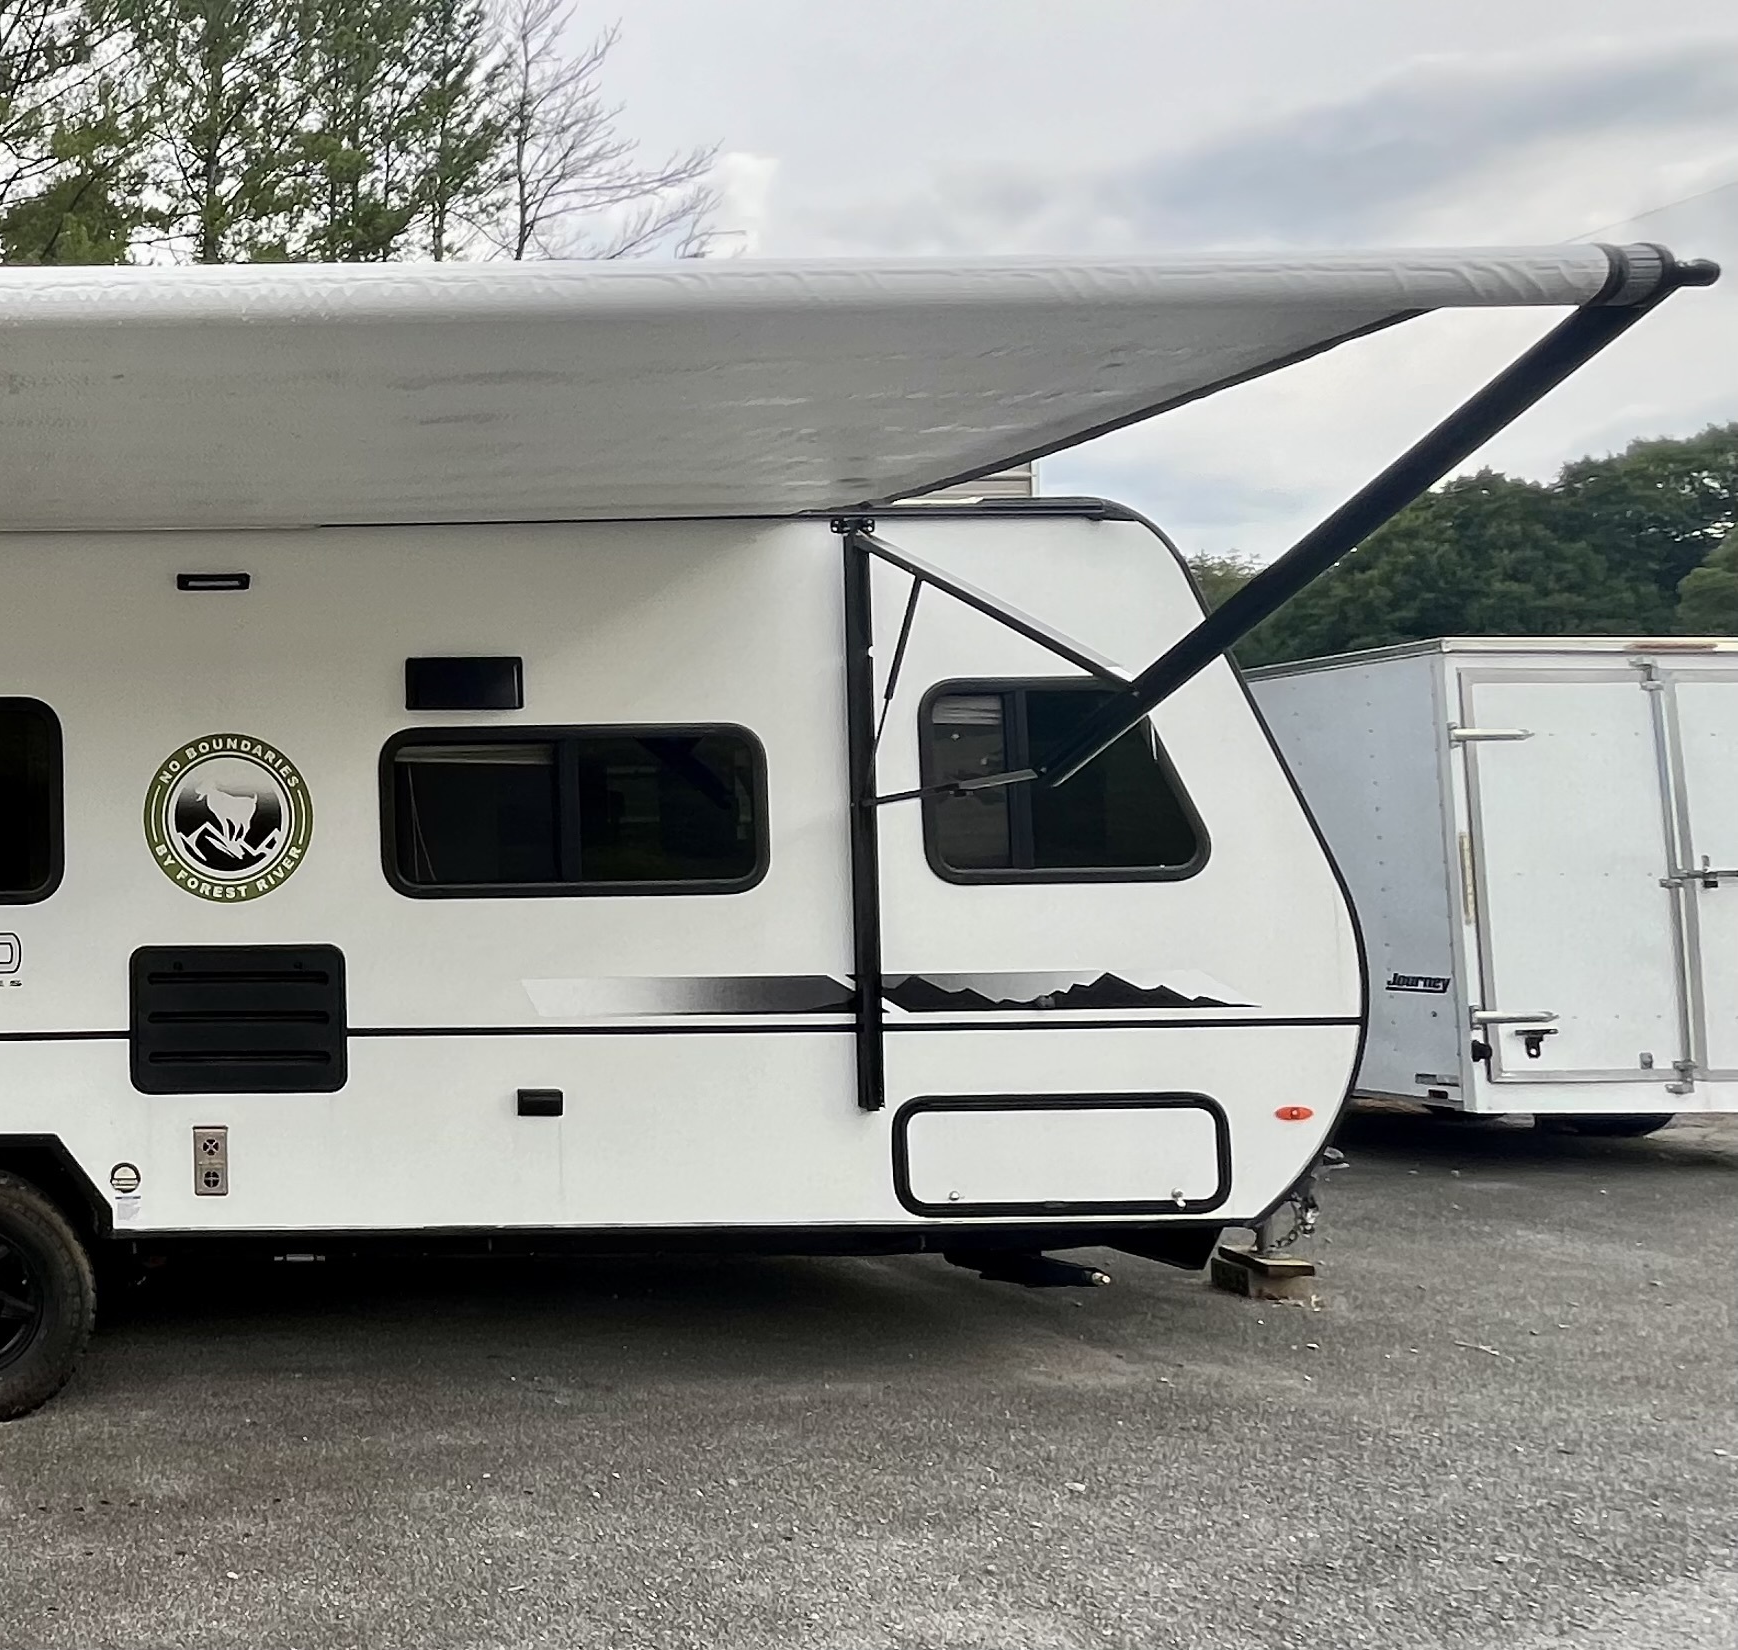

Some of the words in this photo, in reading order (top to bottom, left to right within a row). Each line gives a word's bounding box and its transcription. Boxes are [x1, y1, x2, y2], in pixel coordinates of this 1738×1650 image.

[159, 759, 181, 785] NO
[185, 737, 300, 788] BOUNDARIES
[155, 843, 176, 867] BY
[176, 868, 249, 899] FOREST
[255, 846, 302, 893] RIVER
[1386, 972, 1451, 993] Journey
